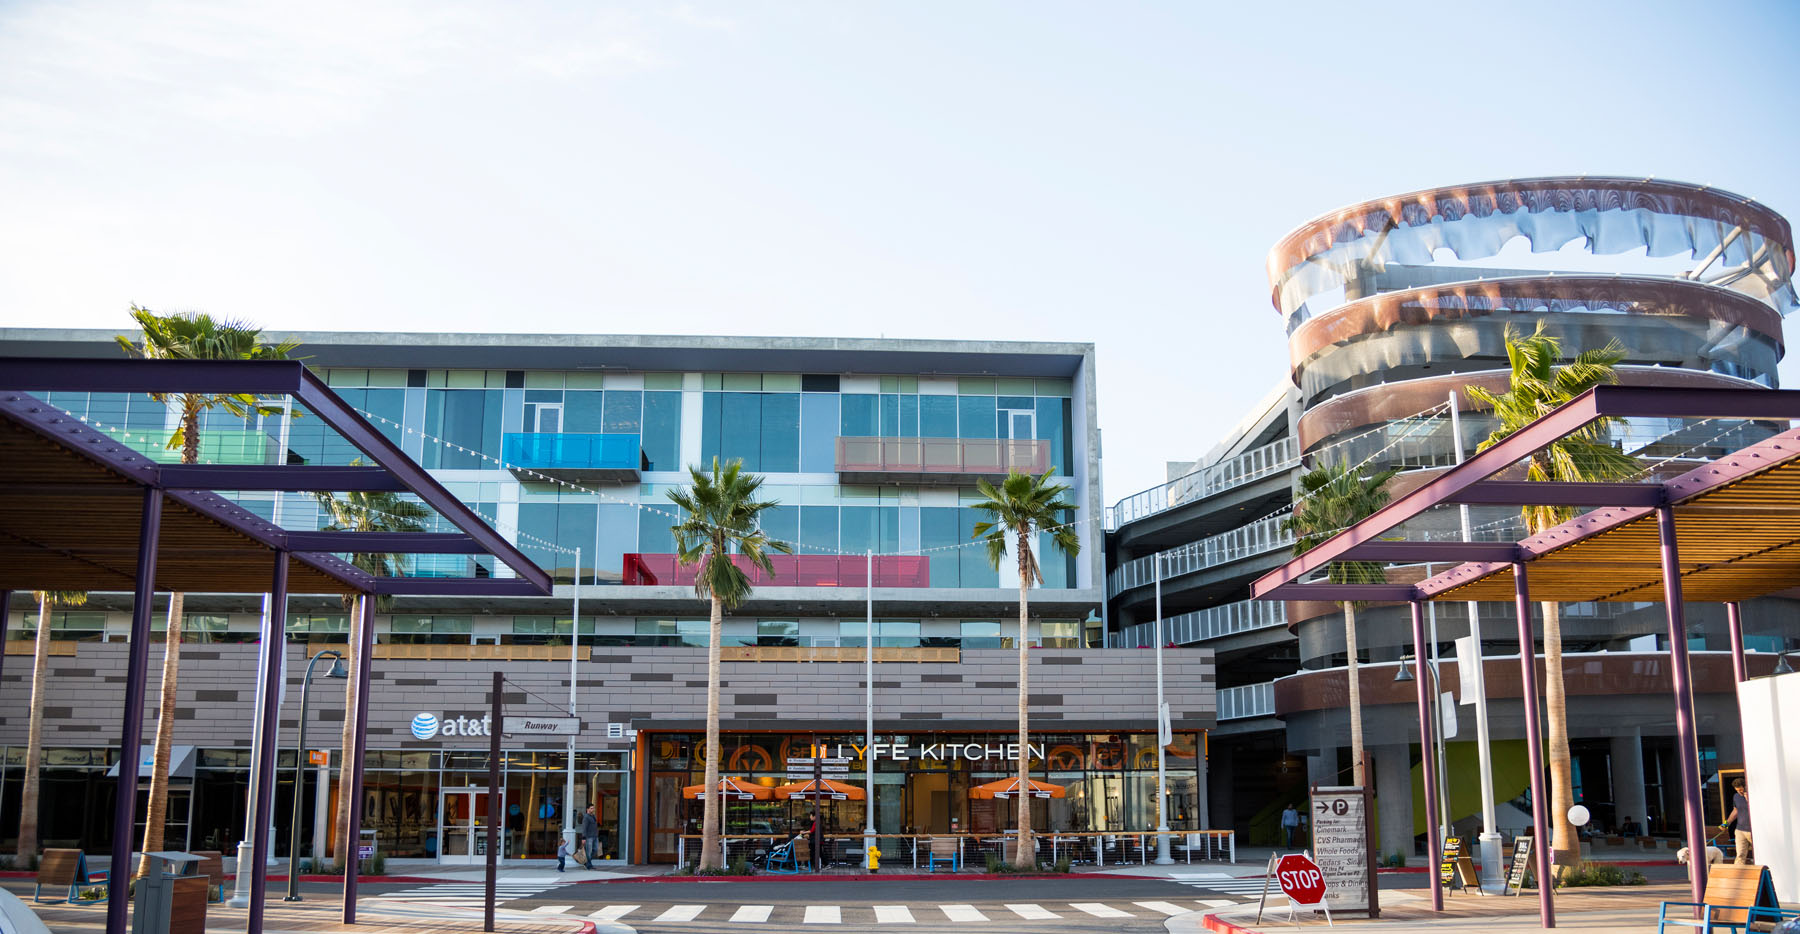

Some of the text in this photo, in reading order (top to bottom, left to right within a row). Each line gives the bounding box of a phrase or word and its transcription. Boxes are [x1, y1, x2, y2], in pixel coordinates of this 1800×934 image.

[442, 714, 492, 736] at&t
[524, 721, 558, 731] Runway
[837, 743, 1045, 761] LYFE KITCHEN
[1316, 825, 1347, 834] Cinemark
[1317, 836, 1365, 845] CVS Pharmacy
[1317, 846, 1359, 855] Whole Foods
[1281, 869, 1320, 890] STOP
[1340, 880, 1346, 888] &
[1325, 891, 1340, 899] anks
